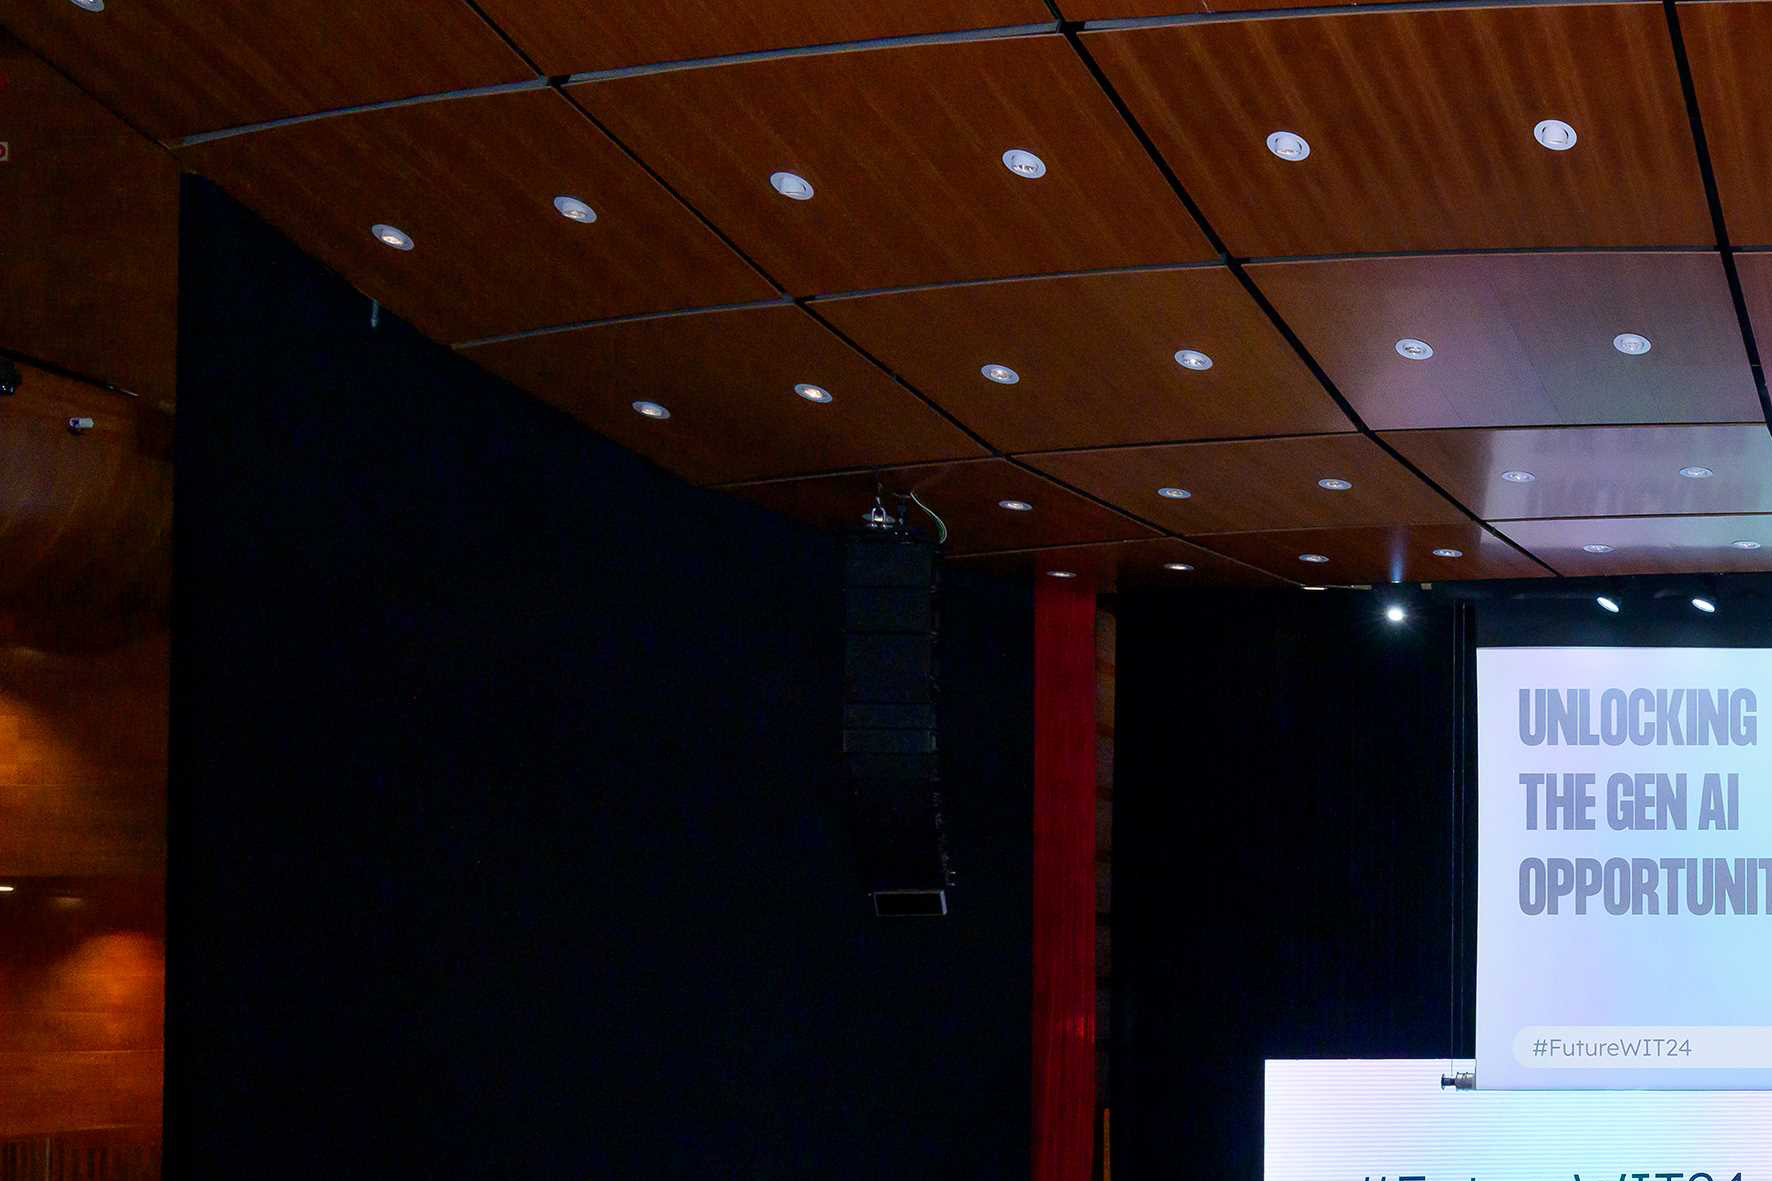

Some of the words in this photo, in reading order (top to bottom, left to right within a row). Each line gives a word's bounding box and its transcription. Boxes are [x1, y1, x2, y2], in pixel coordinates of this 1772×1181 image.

[1518, 687, 1758, 747] UNLOCKING
[1518, 772, 1597, 831] THE
[1606, 772, 1688, 832] GEN
[1697, 772, 1740, 831] AI
[1532, 1038, 1693, 1057] #FutureWIT24
